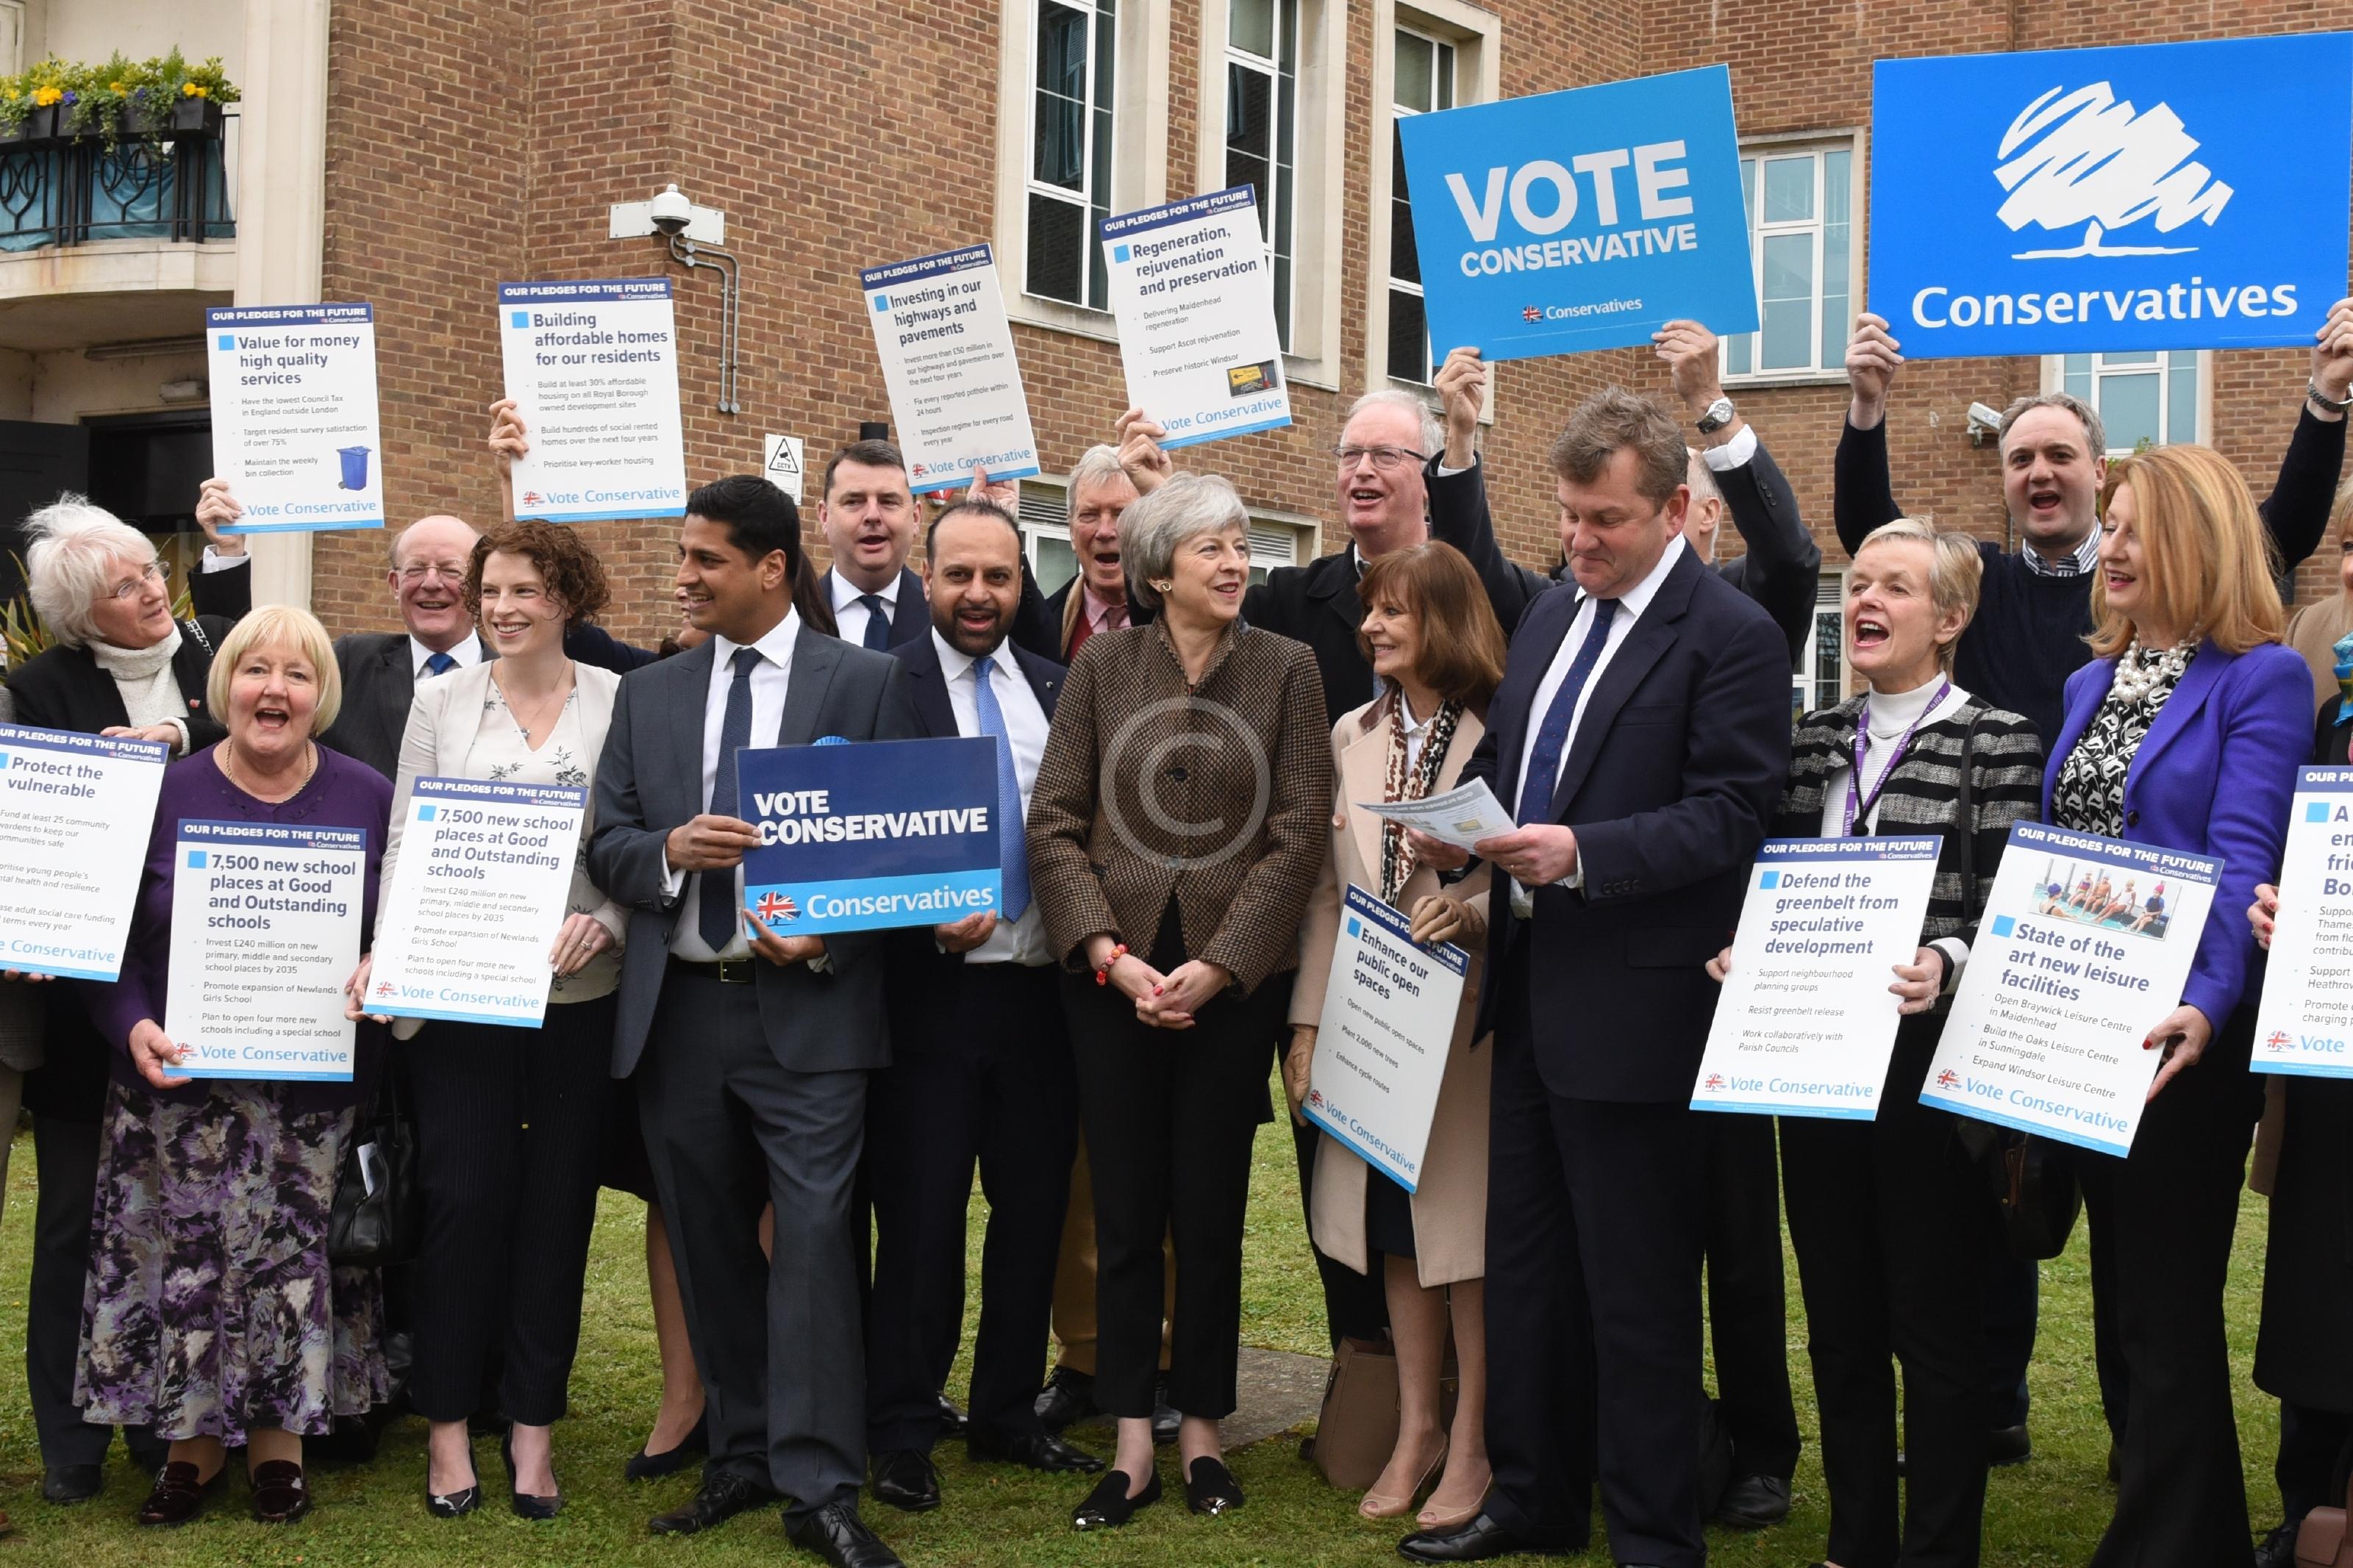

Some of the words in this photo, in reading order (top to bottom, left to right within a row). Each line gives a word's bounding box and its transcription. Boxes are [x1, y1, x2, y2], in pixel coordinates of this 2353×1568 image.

[1444, 140, 1694, 243] VOTE
[1104, 220, 1126, 232] OUR
[1126, 210, 1169, 226] PLEDGES
[1169, 204, 1189, 216] FOR
[1190, 199, 1210, 211] THE
[1210, 190, 1249, 207] FUTURE
[1132, 227, 1231, 259] Regeneration,
[1460, 223, 1698, 277] CONSERVATIVE
[1136, 247, 1224, 278] rejuvenation
[1140, 278, 1165, 296] and
[1168, 259, 1257, 293] preservation
[890, 287, 946, 309] Investing
[946, 282, 960, 297] in
[961, 281, 982, 293] our
[1912, 276, 2299, 328] Conservatives
[893, 307, 952, 328] highways
[953, 298, 977, 315] and
[1143, 307, 1179, 320] Delivering
[1179, 295, 1221, 312] Maidenhead
[1546, 296, 1643, 320] Conservatives
[533, 312, 597, 329] Building
[1145, 316, 1189, 332] regeneration
[238, 336, 281, 350] Value
[284, 334, 306, 348] for
[310, 336, 360, 348] money
[535, 330, 614, 347] affordable
[617, 330, 668, 344] homes
[899, 321, 965, 348] pavements
[240, 354, 273, 370] high
[276, 351, 328, 369] quality
[535, 352, 558, 366] for
[561, 354, 587, 365] our
[591, 348, 661, 364] residents
[240, 371, 301, 386] services
[538, 380, 557, 389] Build
[589, 378, 606, 387] 30%
[607, 377, 647, 386] affordable
[262, 397, 274, 405] the
[276, 396, 301, 404] lowest
[301, 395, 329, 404] Council
[330, 394, 343, 402] Tax
[1161, 418, 1192, 432] Vote
[1196, 398, 1282, 424] Conservative
[929, 462, 954, 473] Vote
[957, 448, 1031, 469] Conservative
[546, 493, 579, 504] Vote
[585, 487, 680, 503] Conservative
[247, 505, 279, 516] Vote
[284, 500, 376, 515] Conservative
[1855, 727, 1865, 751] RBWM
[11, 756, 73, 777] Protect
[76, 765, 104, 780] the
[2305, 772, 2336, 782] OUR
[7, 777, 96, 798] vulnerable
[753, 790, 829, 816] VOTE
[2334, 805, 2349, 822] A
[21, 812, 31, 820] at
[32, 813, 51, 823] least
[52, 815, 65, 824] 25
[65, 818, 111, 831] community
[440, 809, 483, 825] 7,500
[487, 815, 521, 827] new
[522, 815, 574, 831] school
[757, 807, 988, 845] CONSERVATIVE
[1843, 810, 1854, 837] RBWM
[184, 824, 210, 834] OUR
[212, 826, 264, 837] PLEDGES
[265, 828, 290, 839] FOR
[291, 830, 313, 840] THE
[315, 831, 360, 842] FUTURE
[434, 827, 485, 842] places
[488, 831, 504, 845] at
[507, 831, 549, 848] Good
[212, 854, 260, 871] 7,500
[263, 860, 299, 873] new
[302, 859, 356, 876] school
[431, 846, 462, 859] and
[464, 847, 560, 870] Outstanding
[426, 863, 486, 880] schools
[1781, 873, 1841, 889] Defend
[1844, 873, 1871, 888] the
[210, 874, 264, 892] places
[267, 878, 285, 892] at
[288, 877, 332, 894] Good
[208, 895, 240, 909] and
[245, 895, 347, 917] Outstanding
[807, 885, 993, 919] Conservatives
[1775, 895, 1856, 914] greenbelt
[1859, 894, 1899, 910] from
[2319, 906, 2353, 918] Suppo
[207, 914, 271, 930] schools
[1769, 915, 1864, 935] speculative
[1765, 937, 1874, 958] development
[2015, 923, 2065, 948] State
[2069, 937, 2092, 953] of
[2093, 940, 2125, 961] the
[2315, 932, 2339, 942] from
[11, 939, 115, 963] Conservative
[1361, 927, 1407, 967] Enhance
[1409, 962, 1429, 980] our
[204, 963, 232, 972] school
[234, 964, 261, 973] places
[263, 965, 274, 975] by
[276, 965, 298, 974] 2035
[1356, 950, 1390, 978] public
[1392, 972, 1420, 998] open
[1757, 968, 1790, 979] Support
[1790, 969, 1854, 980] neighbourhood
[2008, 950, 2037, 967] art
[2038, 956, 2081, 976] new
[2083, 962, 2150, 992] leisure
[2310, 965, 2351, 978] Support
[1353, 968, 1390, 1000] spaces
[1753, 981, 1789, 992] planning
[1790, 984, 1818, 993] groups
[2001, 968, 2080, 1001] facilities
[202, 994, 222, 1003] Girls
[224, 994, 252, 1003] School
[401, 985, 435, 1000] Vote
[439, 988, 539, 1009] Conservative
[2304, 999, 2349, 1011] Promote
[1989, 1006, 1999, 1017] in
[1999, 1009, 2057, 1031] Maidenhead
[1994, 993, 2019, 1006] Open
[2020, 998, 2063, 1017] Braywick
[2064, 1009, 2099, 1025] Leisure
[2101, 1017, 2132, 1034] Centre
[2302, 1013, 2347, 1026] charging
[201, 1045, 236, 1059] Vote
[243, 1046, 348, 1063] Conservative
[1340, 1024, 1356, 1040] Plant
[1355, 1034, 1373, 1050] 2,000
[1372, 1046, 1385, 1059] new
[1385, 1053, 1399, 1069] trees
[1978, 1037, 1988, 1048] in
[1988, 1040, 2046, 1062] Sunningdale
[1983, 1023, 2007, 1037] Build
[2008, 1030, 2024, 1042] the
[2025, 1034, 2049, 1048] Oaks
[2050, 1040, 2085, 1056] Leisure
[2087, 1049, 2119, 1065] Centre
[2300, 1035, 2345, 1053] Vote
[1731, 1076, 1763, 1092] Vote
[1768, 1078, 1874, 1098] Conservative
[1967, 1077, 2004, 1100] Vote
[2009, 1089, 2128, 1133] Conservative
[1326, 1099, 1348, 1125] Vote
[1349, 1118, 1415, 1174] Conservative
